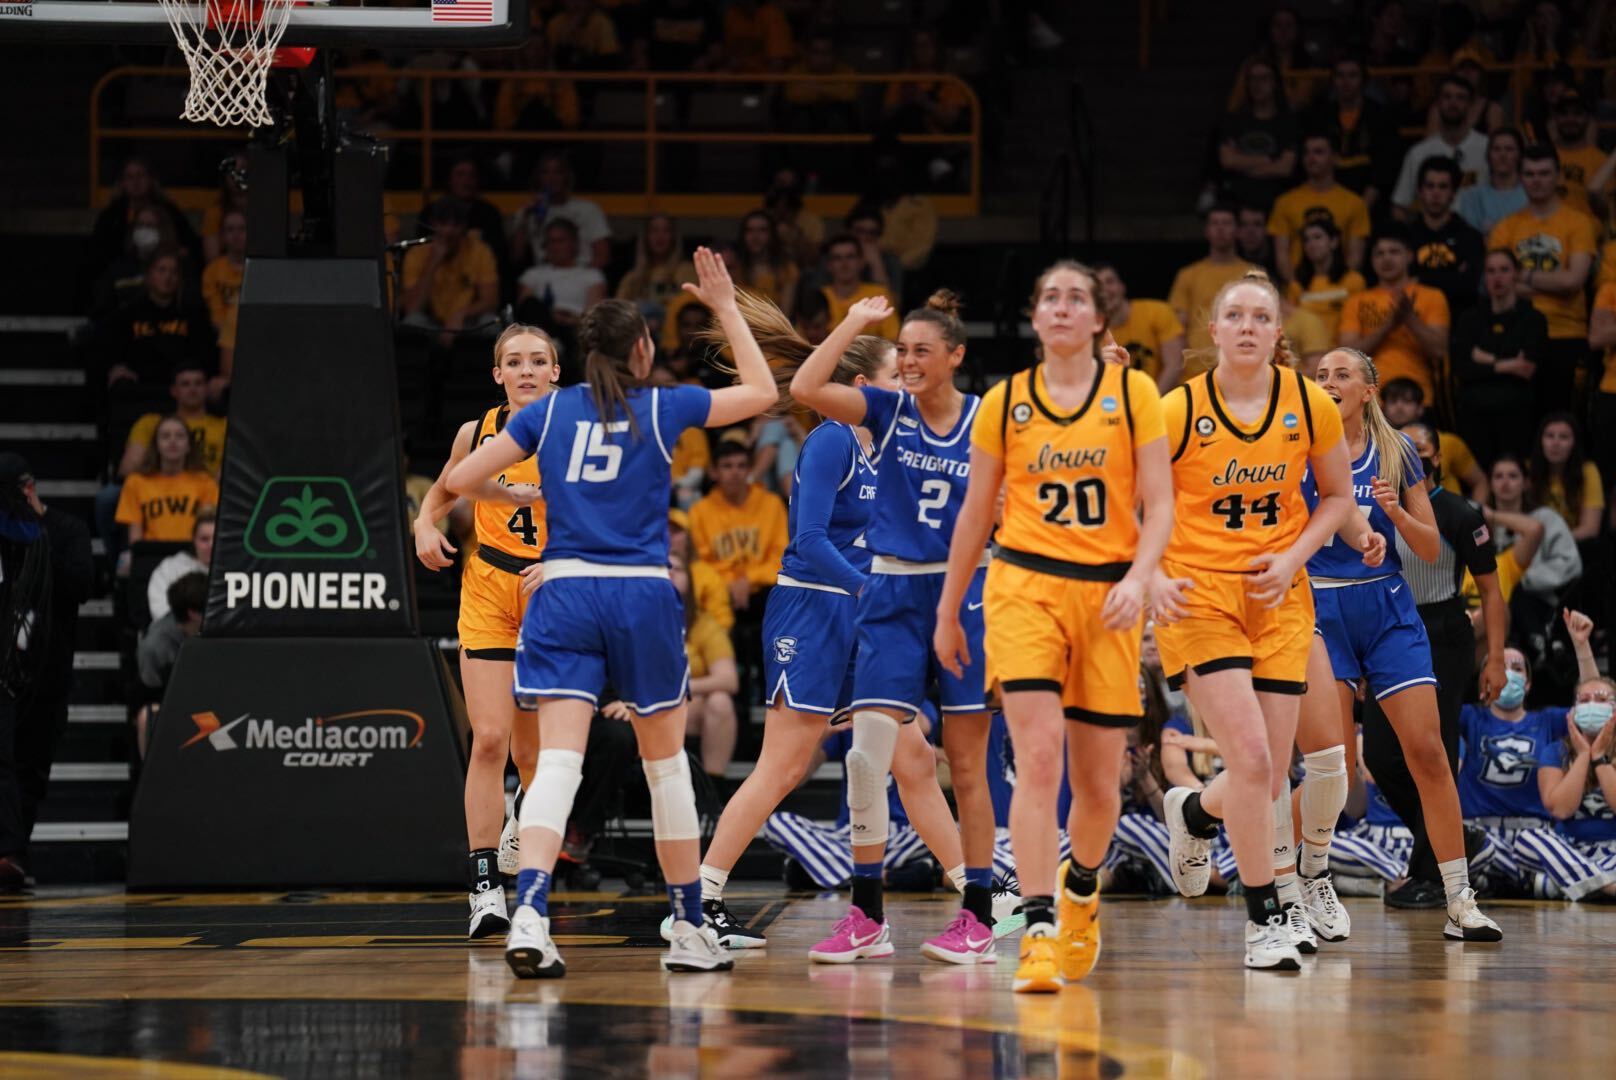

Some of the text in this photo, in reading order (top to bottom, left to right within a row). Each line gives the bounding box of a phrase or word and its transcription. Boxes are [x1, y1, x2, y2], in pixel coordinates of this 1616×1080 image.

[565, 420, 630, 483] 15
[1027, 443, 1107, 474] Iowa
[1212, 458, 1287, 486] Iowa
[917, 479, 951, 529] 2
[1038, 477, 1107, 527] 20
[1211, 491, 1281, 530] 44
[506, 505, 538, 547] 4
[223, 571, 388, 610] PIONEER
[245, 717, 408, 750] Mediacom
[282, 751, 373, 768] COURT
